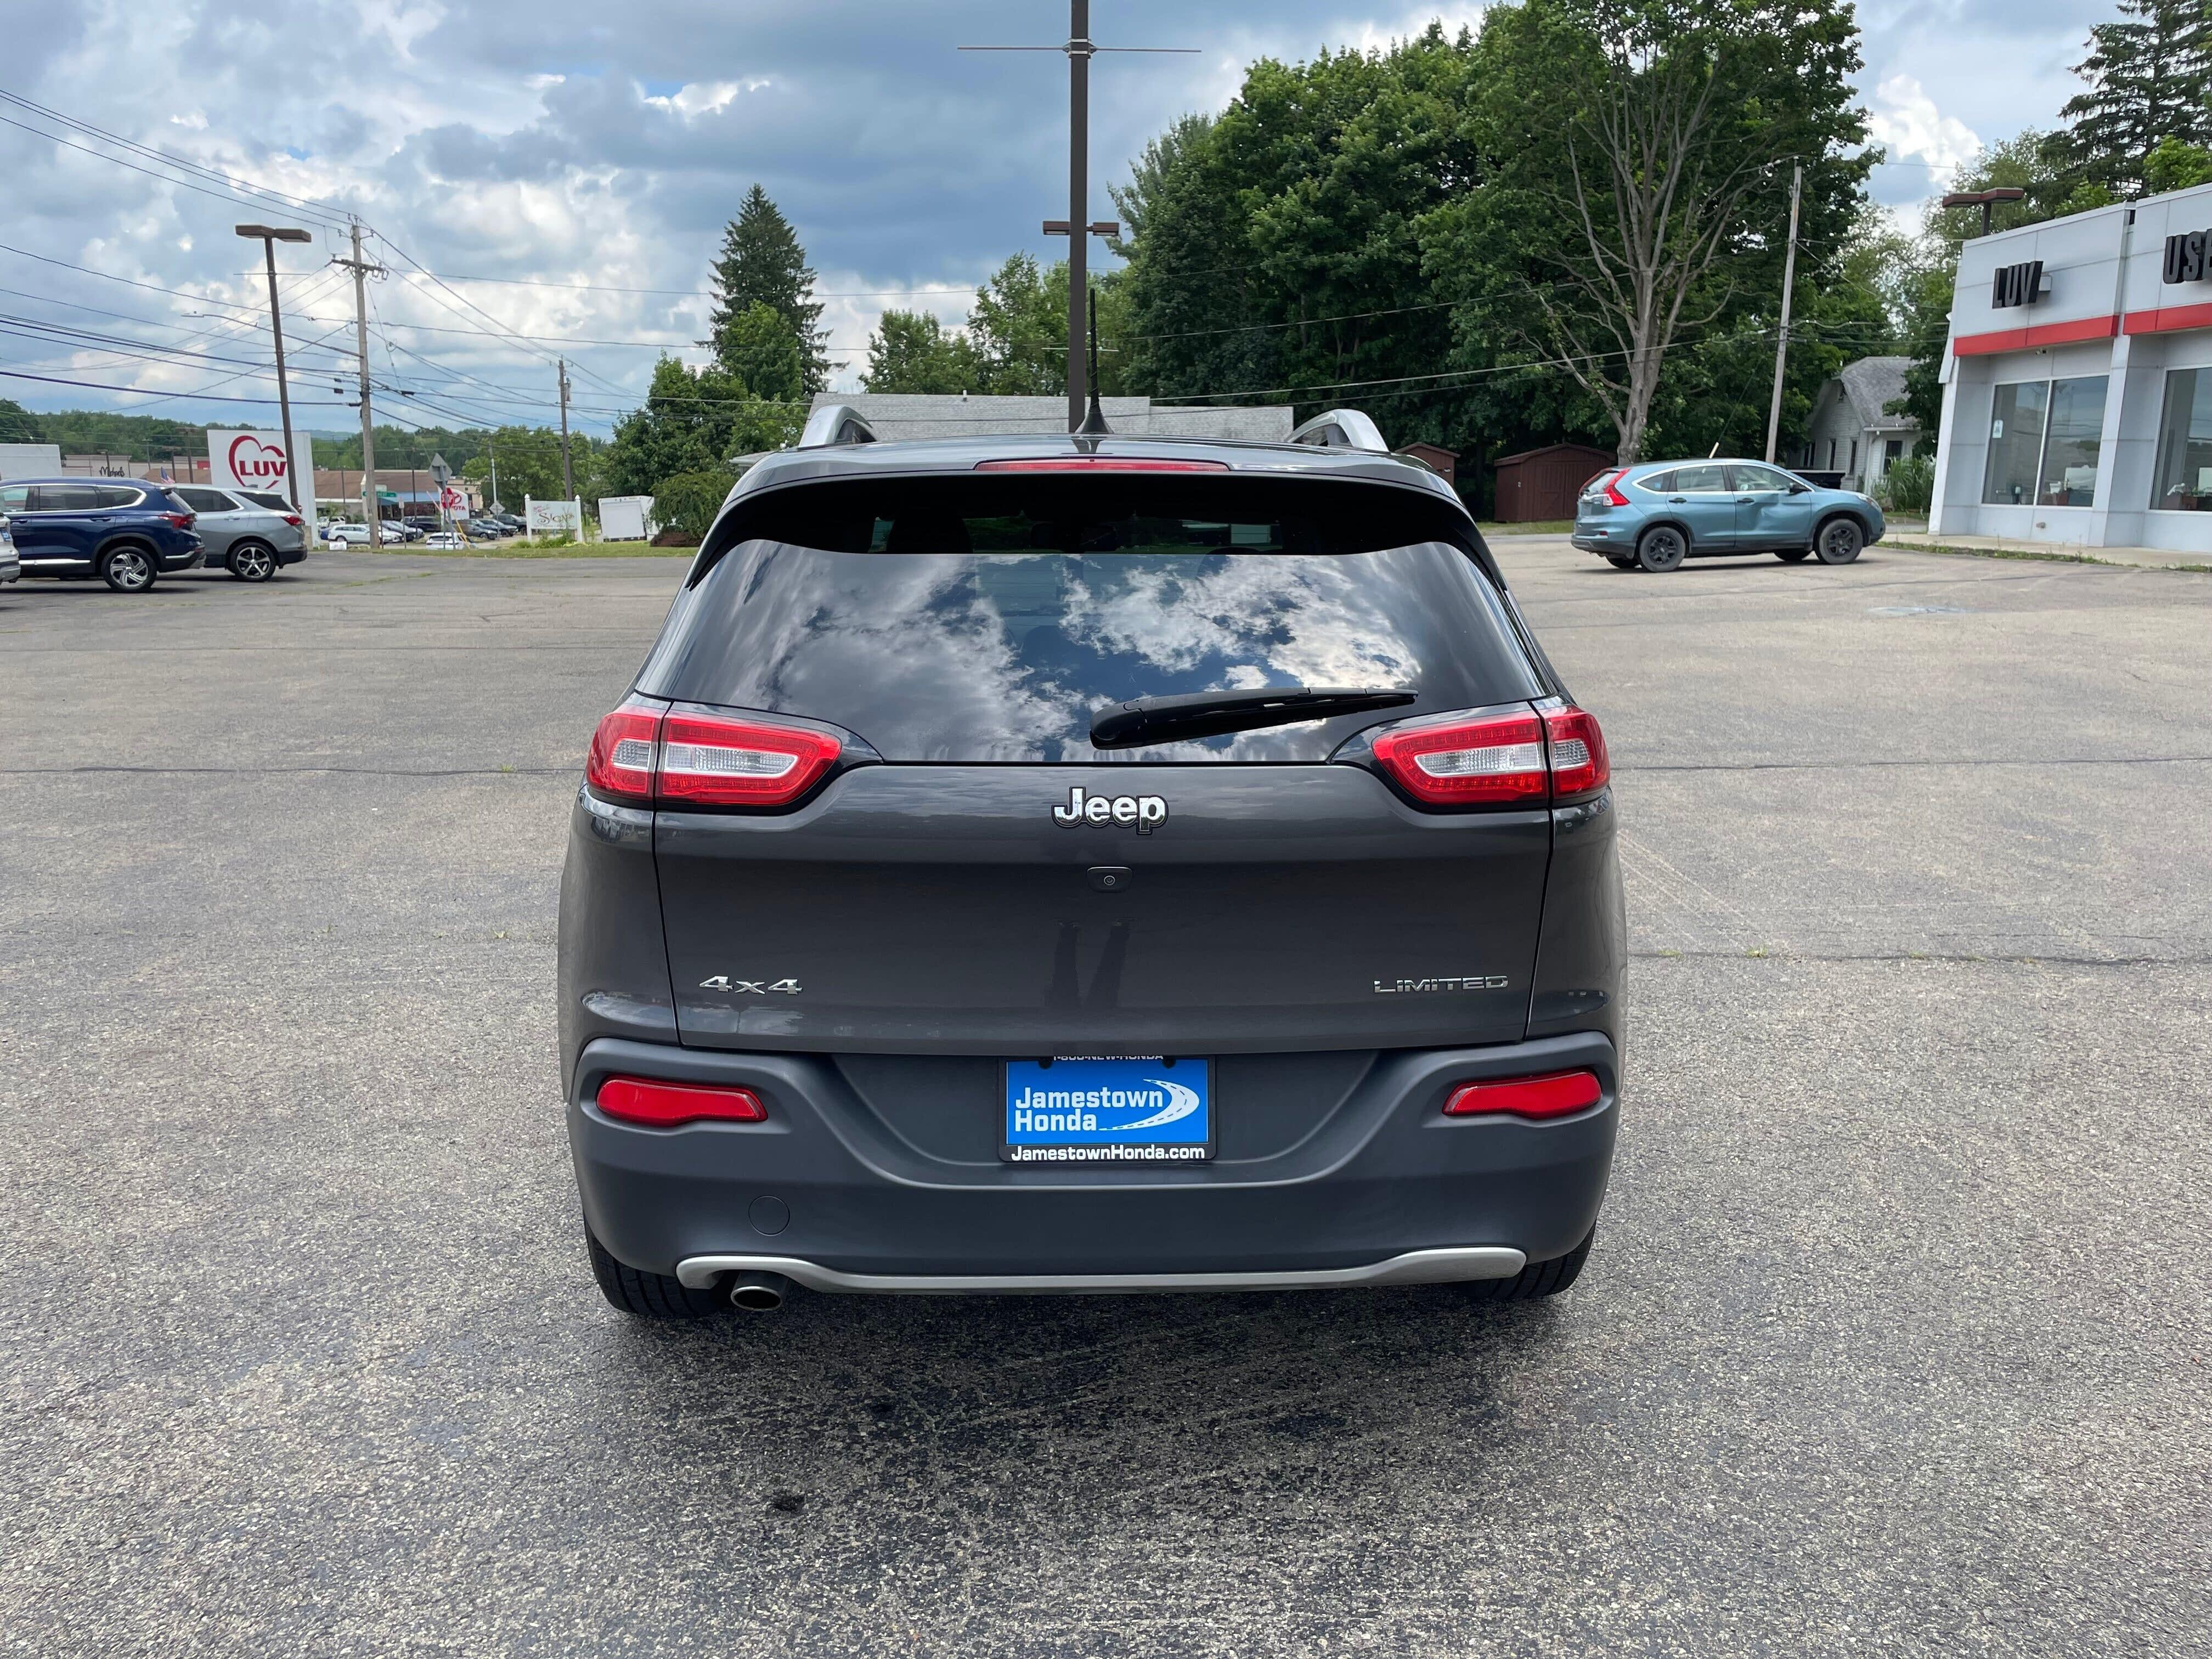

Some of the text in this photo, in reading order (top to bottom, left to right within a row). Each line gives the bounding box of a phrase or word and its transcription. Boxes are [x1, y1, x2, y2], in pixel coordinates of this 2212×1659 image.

[1993, 261, 2044, 309] LUV
[239, 460, 287, 476] LUV
[1052, 787, 1167, 834] Jeep
[699, 975, 804, 995] 4x4
[1374, 975, 1508, 993] LIMITED
[1015, 1087, 1164, 1109] Jamestown
[1015, 1108, 1097, 1132] Honda
[1011, 1144, 1205, 1161] JamestownHonda.com
